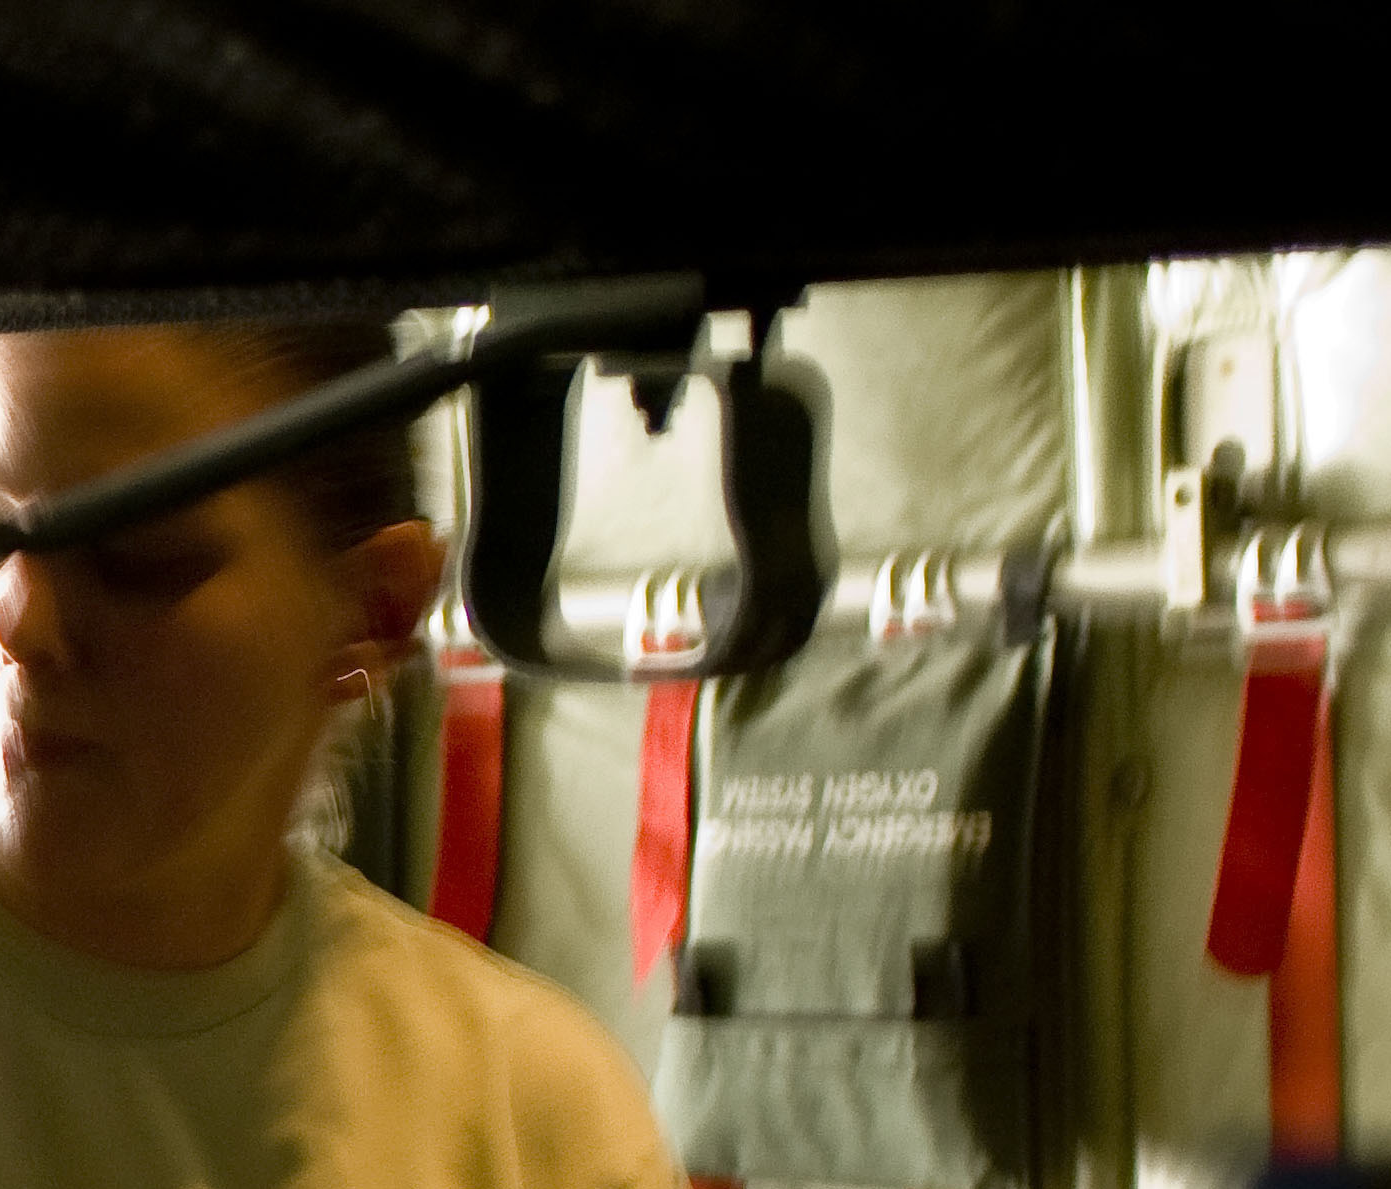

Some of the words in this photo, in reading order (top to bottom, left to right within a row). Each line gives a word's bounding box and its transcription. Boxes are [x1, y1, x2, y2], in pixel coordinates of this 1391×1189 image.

[721, 772, 814, 811] SYSTEM
[822, 768, 939, 811] OXYGEN
[822, 812, 992, 855] EMERGENCY
